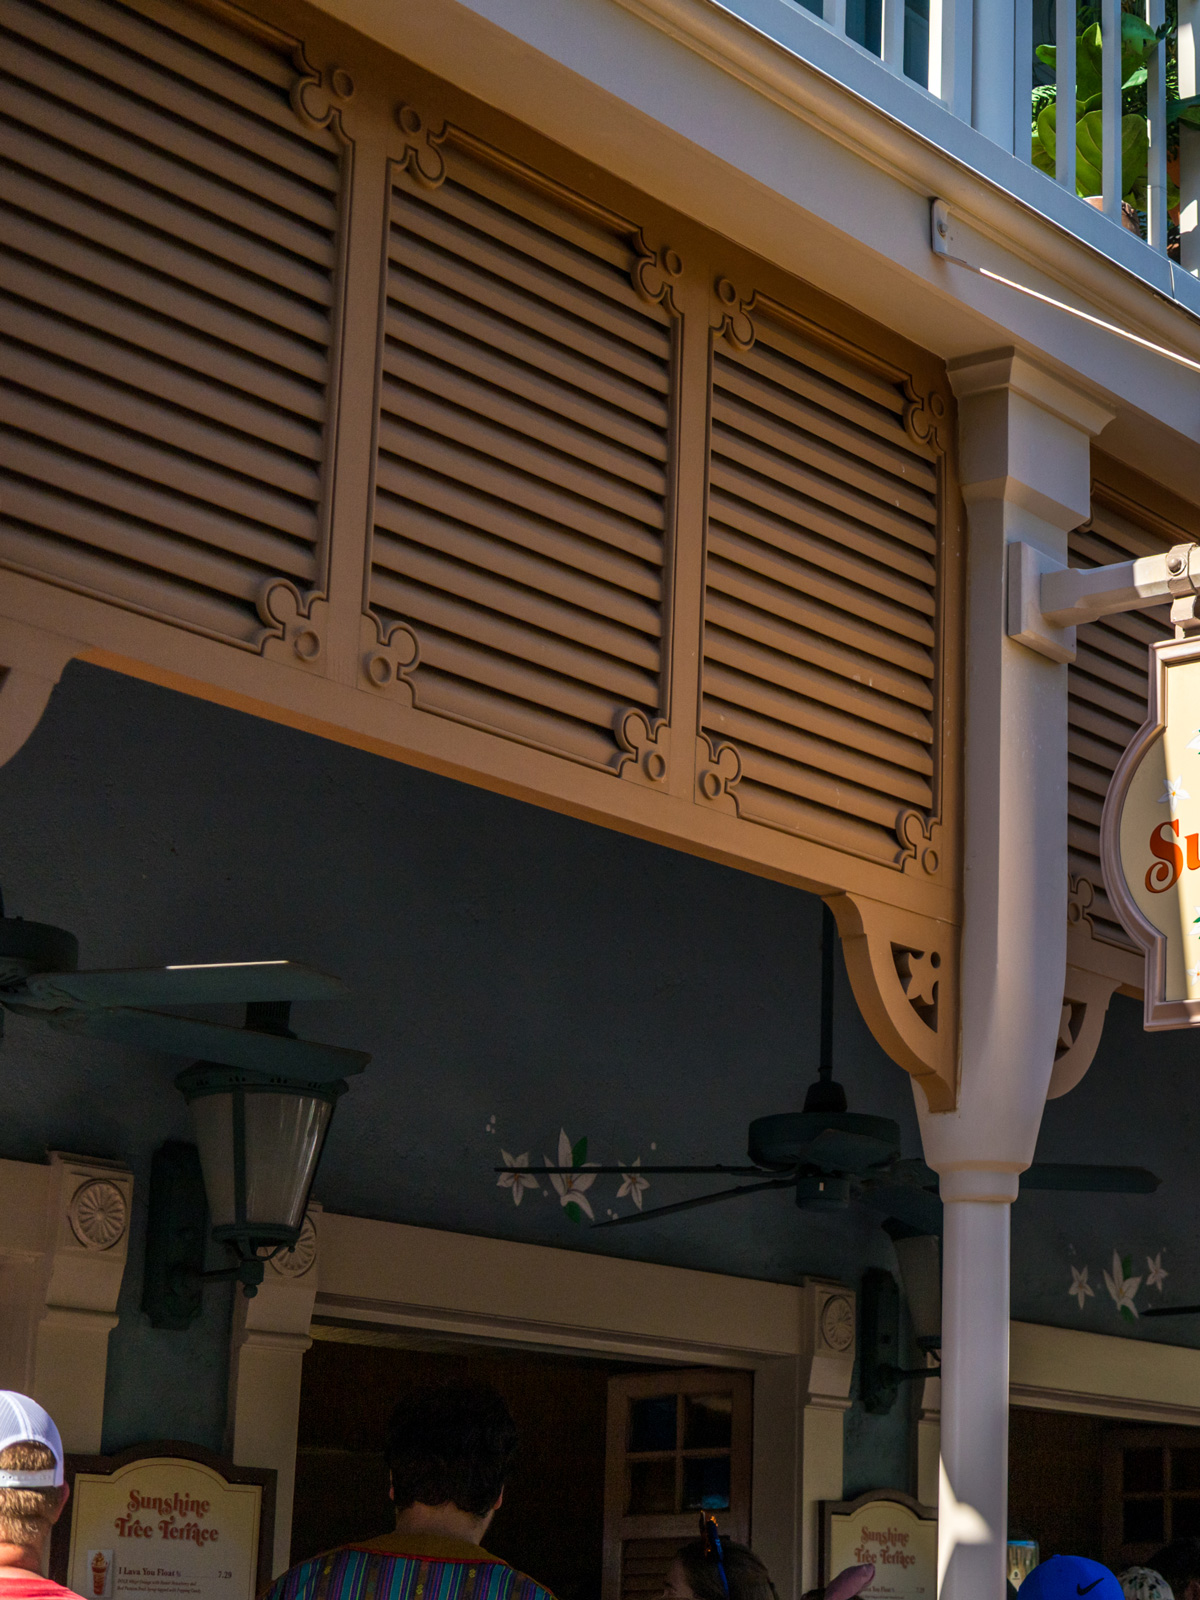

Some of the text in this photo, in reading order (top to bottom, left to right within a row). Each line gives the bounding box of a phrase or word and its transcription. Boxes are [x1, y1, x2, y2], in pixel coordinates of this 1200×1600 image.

[127, 1489, 210, 1518] Sunshine
[114, 1512, 219, 1547] Tree Terrace
[861, 1526, 910, 1547] Sunshine
[854, 1544, 916, 1569] Tree Terrace
[142, 1567, 156, 1577] You
[157, 1568, 175, 1577] Float
[218, 1571, 233, 1579] 7.29
